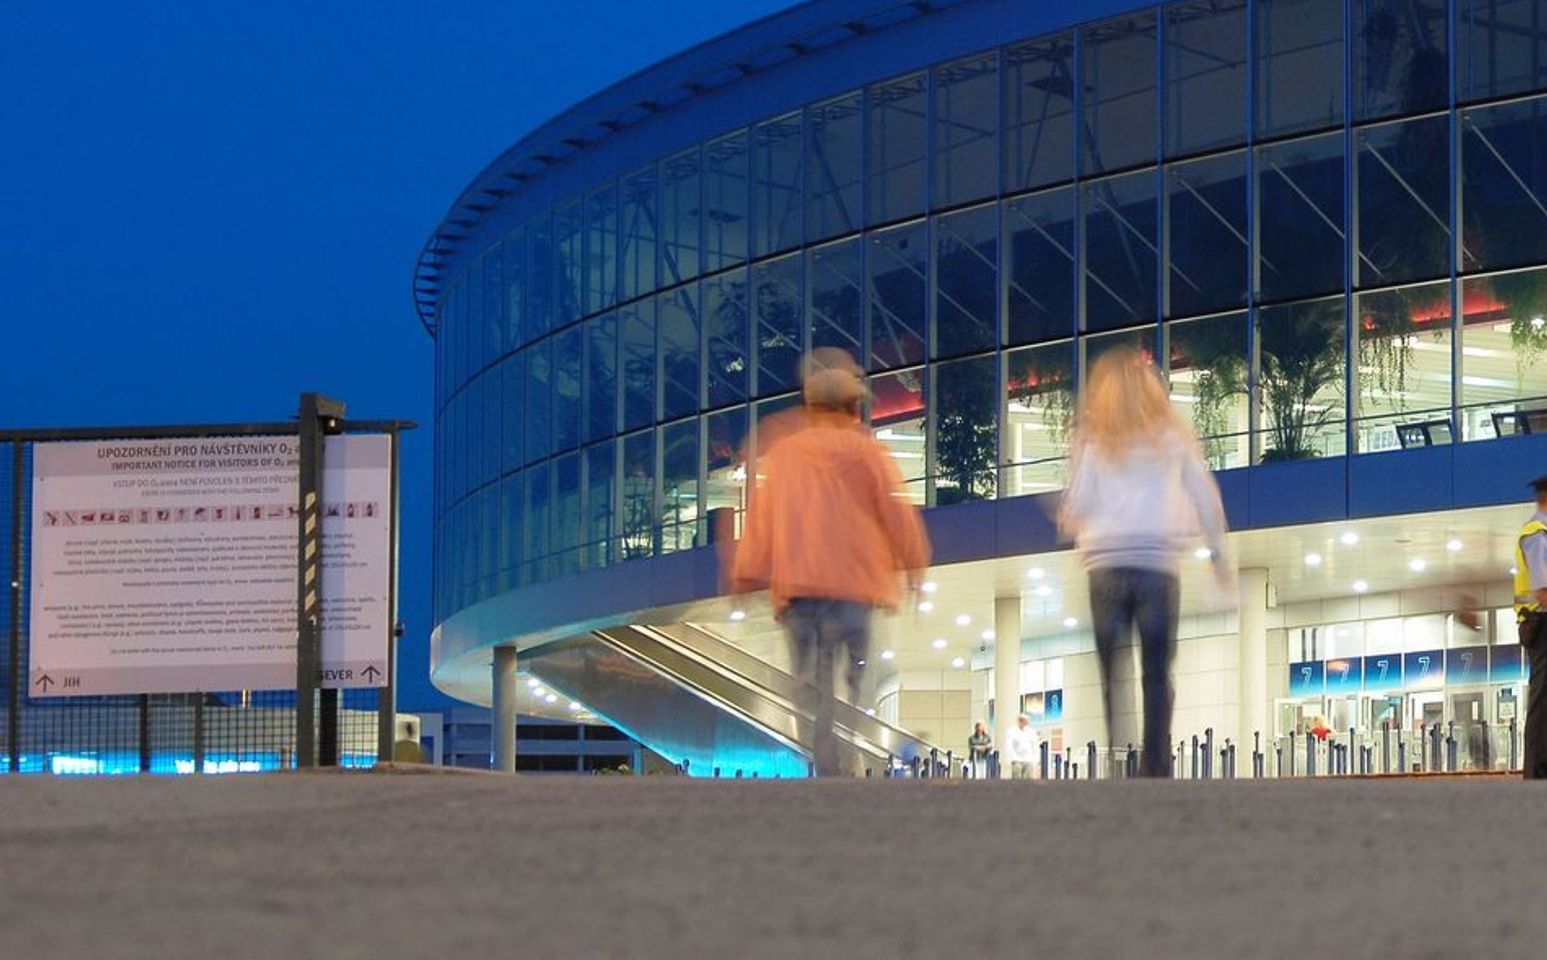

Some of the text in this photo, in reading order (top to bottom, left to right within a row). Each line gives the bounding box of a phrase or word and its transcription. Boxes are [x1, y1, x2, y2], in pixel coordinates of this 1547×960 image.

[174, 445, 198, 457] PRO
[112, 460, 162, 471] IMPORTANT
[164, 459, 196, 470] NOTICE
[198, 459, 216, 469] FOR
[218, 458, 259, 468] VISITORS
[260, 458, 272, 467] OF
[1376, 659, 1390, 681] 7
[1417, 655, 1431, 678] 7
[1460, 651, 1474, 674] 7
